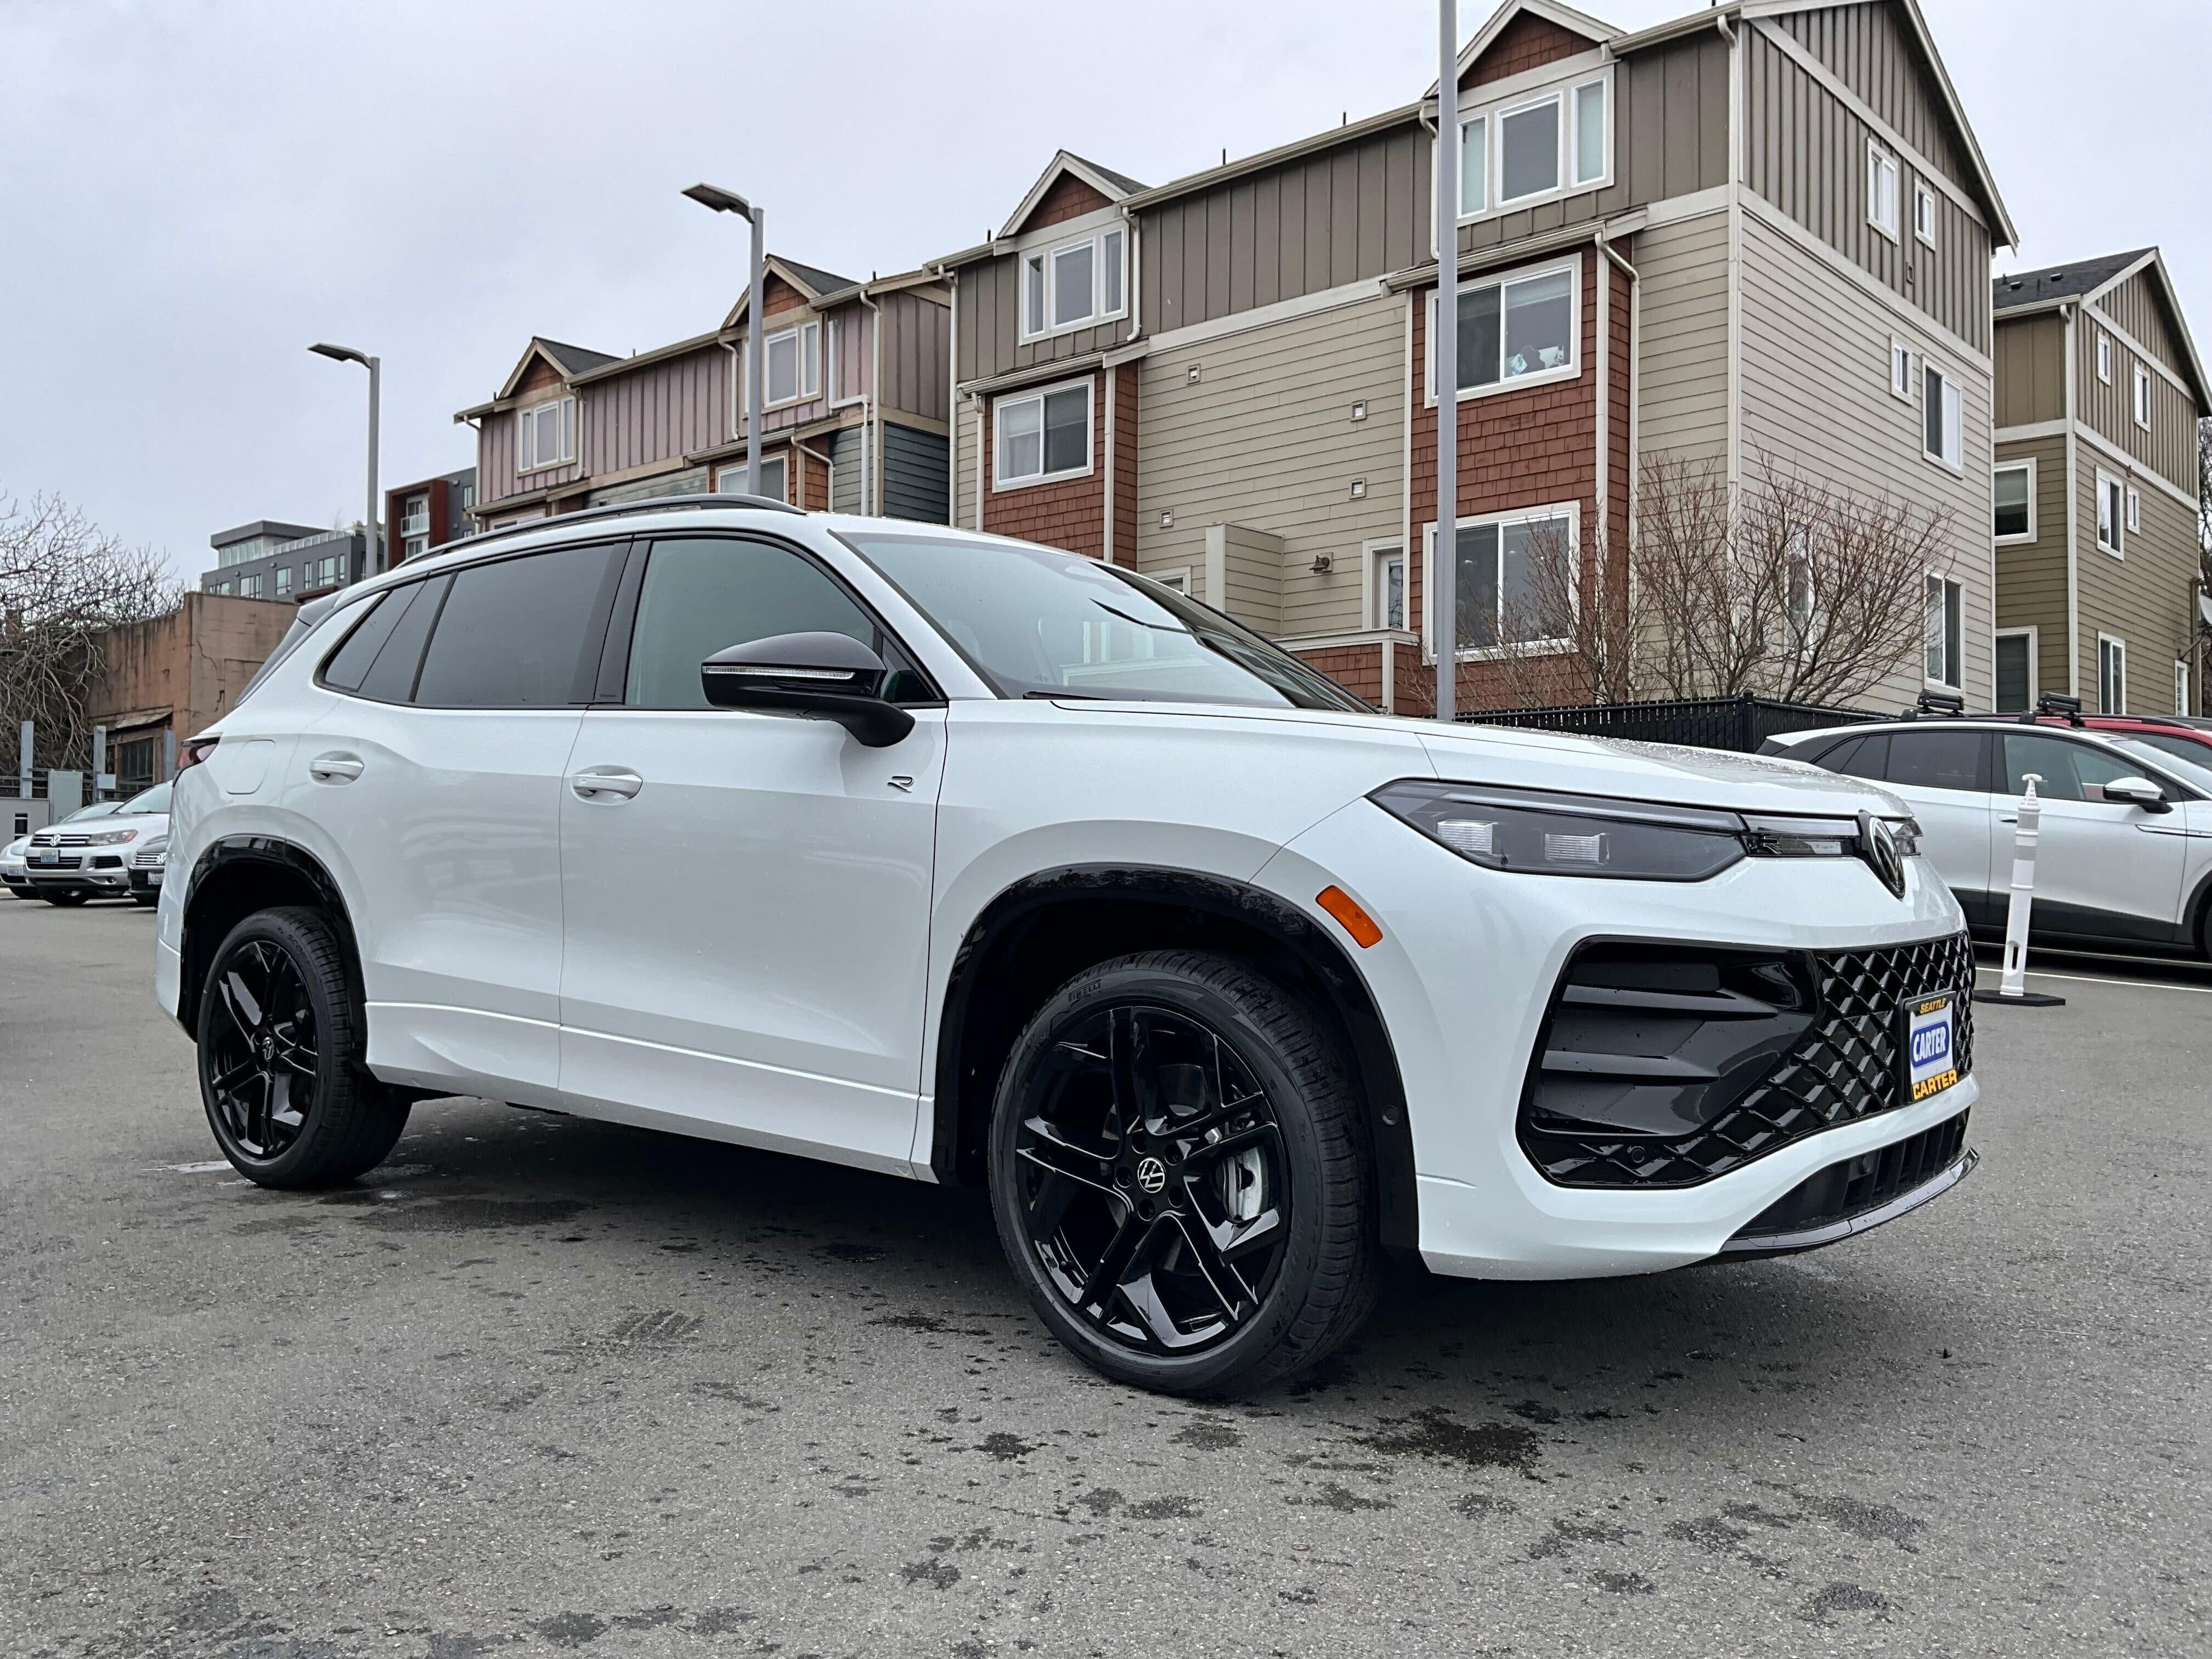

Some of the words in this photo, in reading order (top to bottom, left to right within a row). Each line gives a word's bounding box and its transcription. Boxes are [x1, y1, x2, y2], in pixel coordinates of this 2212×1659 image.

[1920, 997, 1946, 1014] SEATTLE
[1913, 1026, 1946, 1062] CARTER
[1912, 1070, 1957, 1100] CARTER
